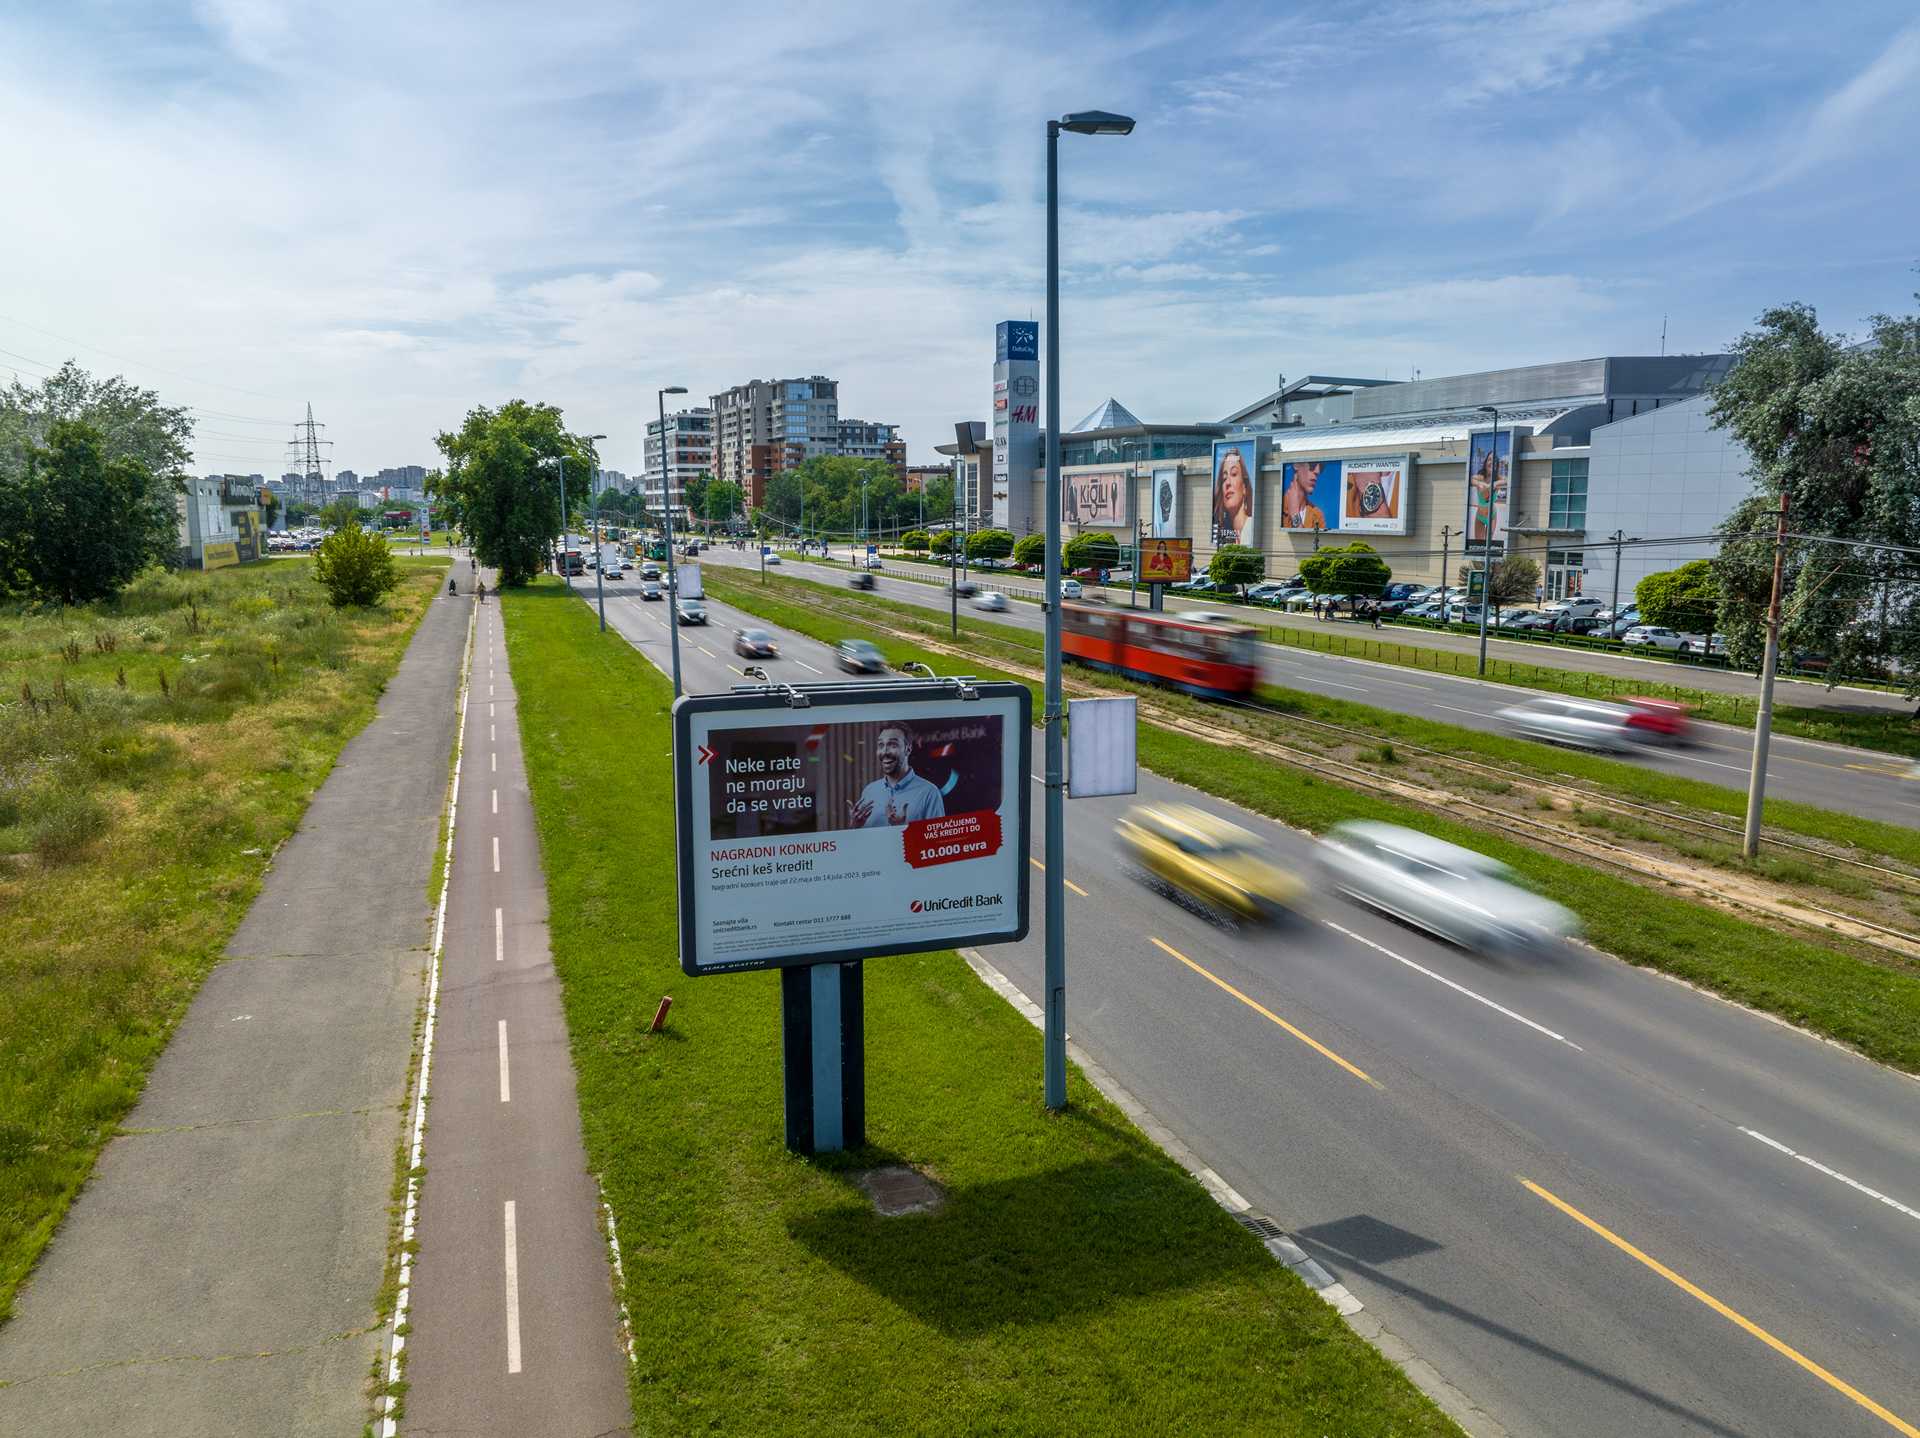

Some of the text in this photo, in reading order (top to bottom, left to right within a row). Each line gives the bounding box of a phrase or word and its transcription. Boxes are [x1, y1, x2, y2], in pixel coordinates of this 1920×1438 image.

[725, 756, 801, 774] Neke rate
[726, 775, 806, 794] ne moraju
[726, 795, 812, 814] da se vrate
[924, 830, 939, 840] VAŠ
[939, 828, 965, 837] KREDIT
[970, 824, 981, 832] DO
[710, 840, 837, 862] NAGRADNI KONKURS
[920, 841, 987, 860] 10.000 evra
[711, 859, 813, 879] Srećni keš kredit!
[924, 893, 1003, 912] UniCredit Bank
